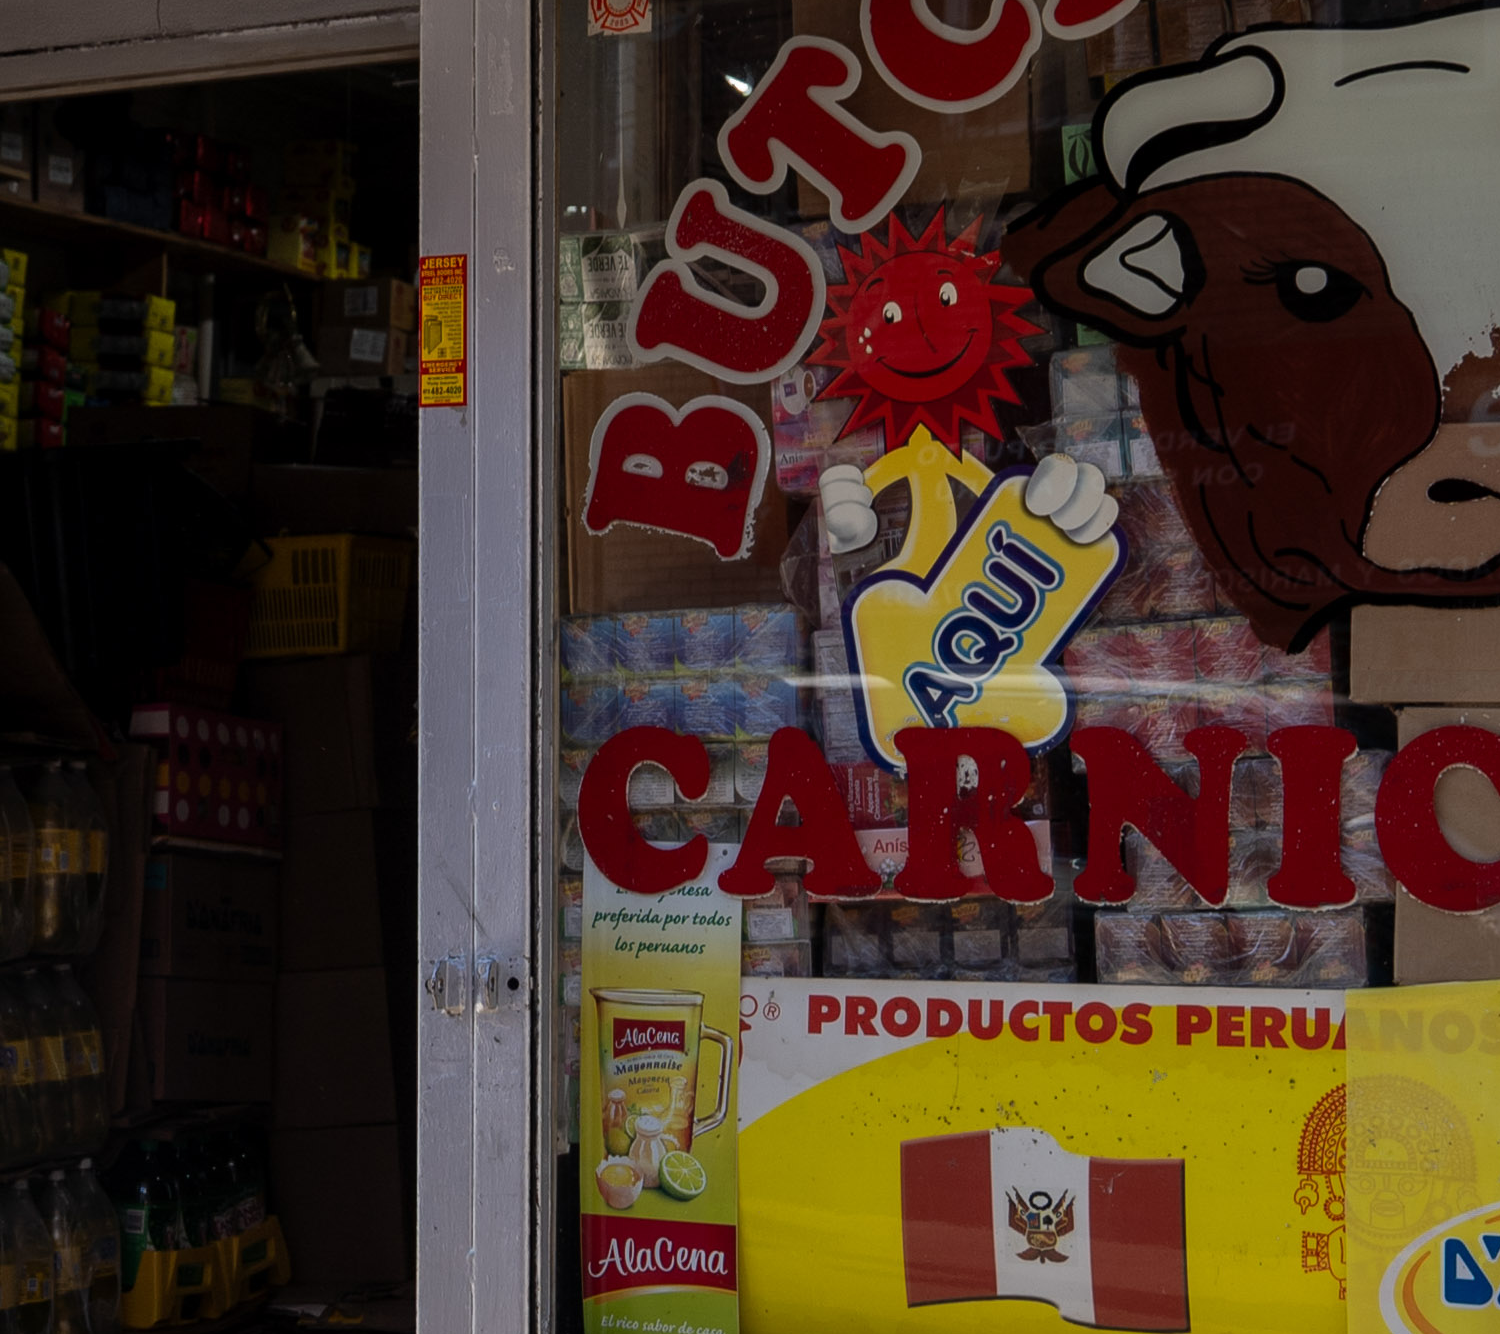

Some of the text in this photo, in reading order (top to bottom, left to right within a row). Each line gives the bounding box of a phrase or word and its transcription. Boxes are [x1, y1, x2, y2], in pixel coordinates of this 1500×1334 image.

[423, 256, 465, 269] JERSEY
[903, 521, 1066, 728] AQUÍ
[592, 908, 732, 932] preferida por todos
[614, 935, 706, 959] los peruanos
[806, 994, 1154, 1047] PRODUCTOS
[615, 1026, 681, 1049] AlaCena
[587, 1236, 729, 1279] AlaCena
[600, 1314, 615, 1328] El
[616, 1316, 640, 1330] rico
[642, 1318, 676, 1333] sabor
[677, 1322, 694, 1334] de
